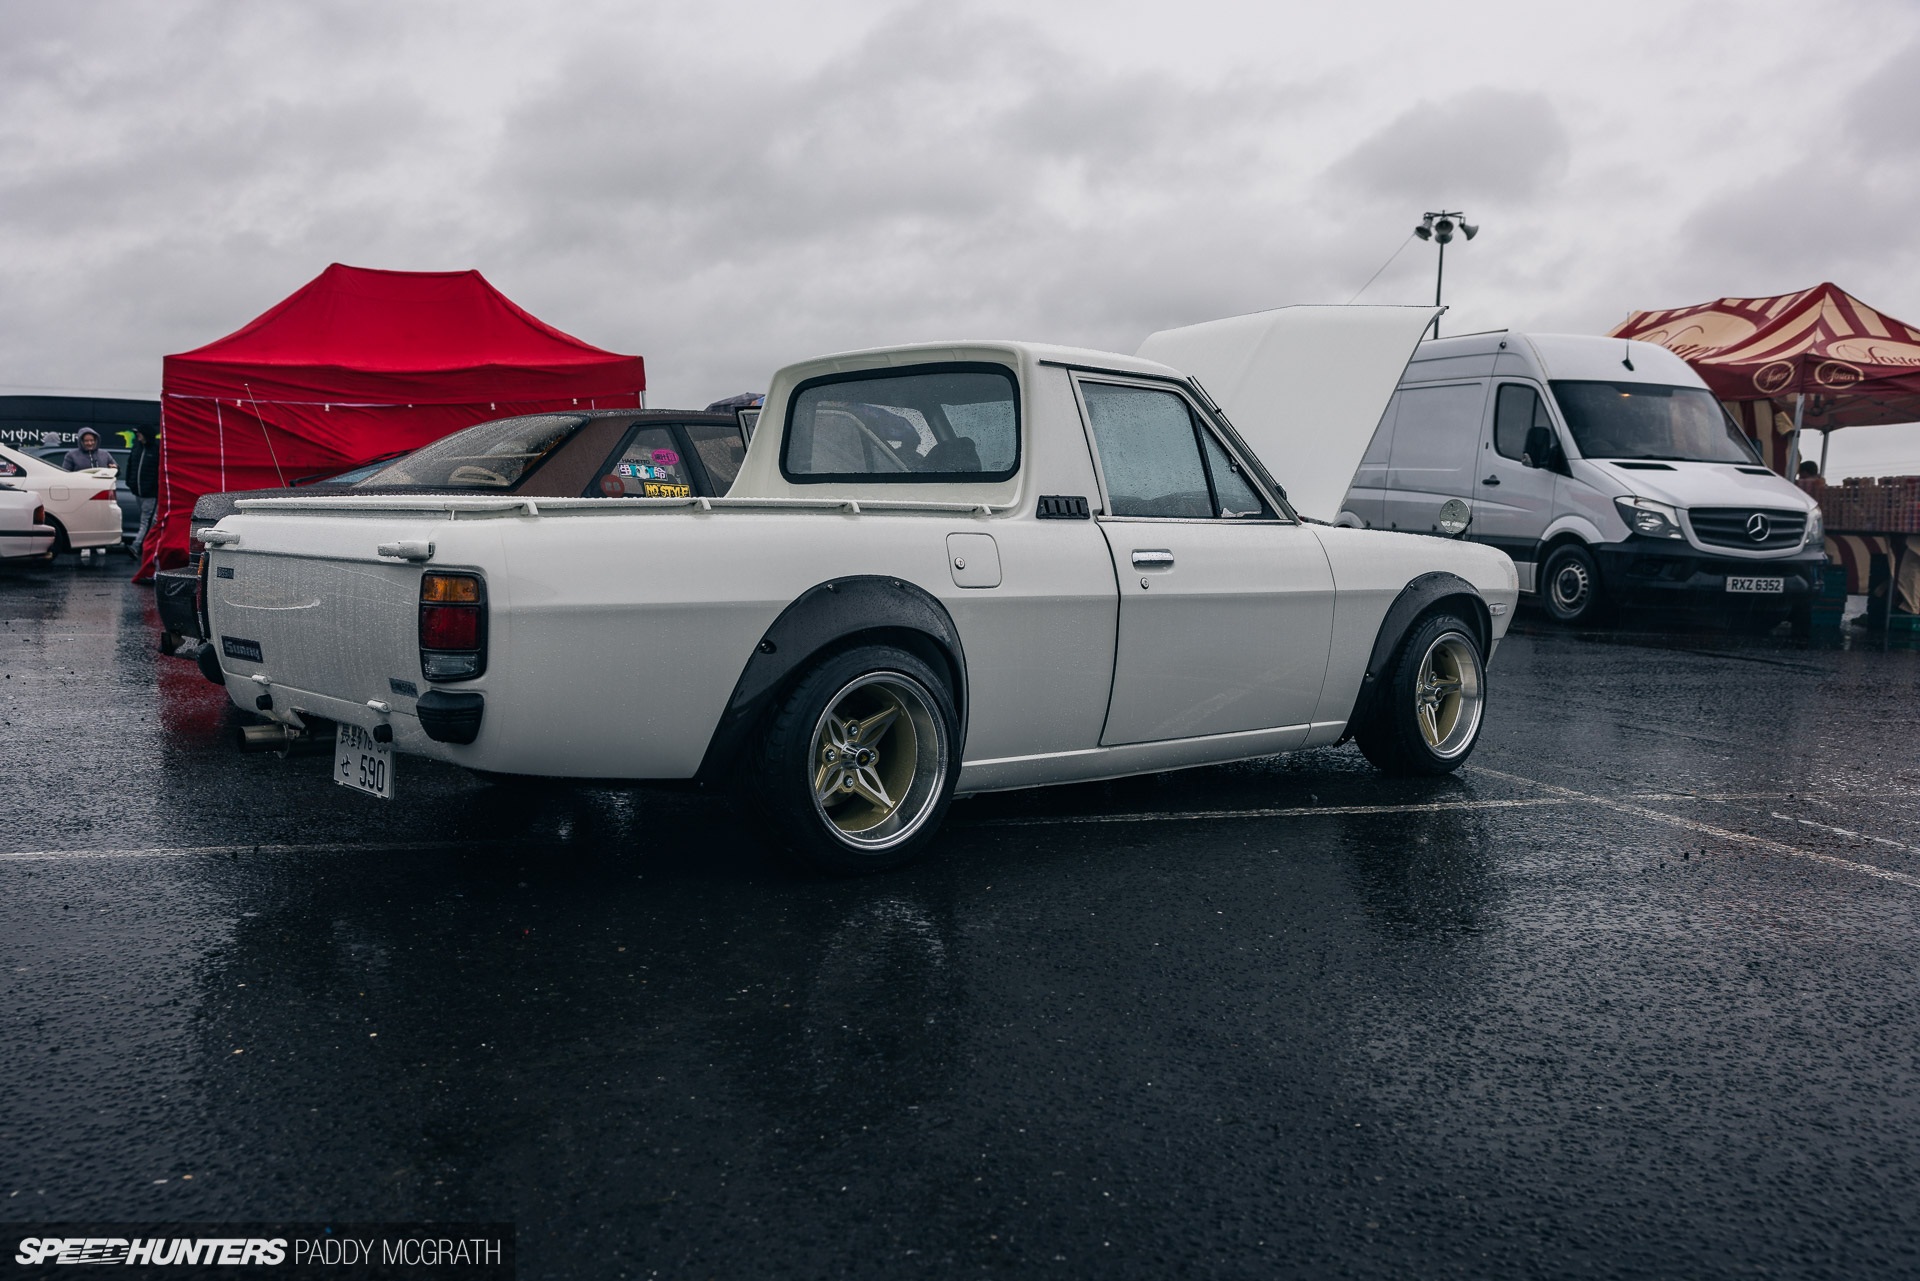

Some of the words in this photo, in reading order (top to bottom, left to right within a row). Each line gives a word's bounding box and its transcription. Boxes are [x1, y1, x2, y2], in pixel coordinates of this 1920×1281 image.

[660, 486, 688, 498] STYLE
[1731, 579, 1753, 591] RXZ
[1755, 580, 1780, 591] 6352
[225, 640, 260, 660] Sunny
[340, 753, 351, 777] せ
[359, 754, 385, 792] 590
